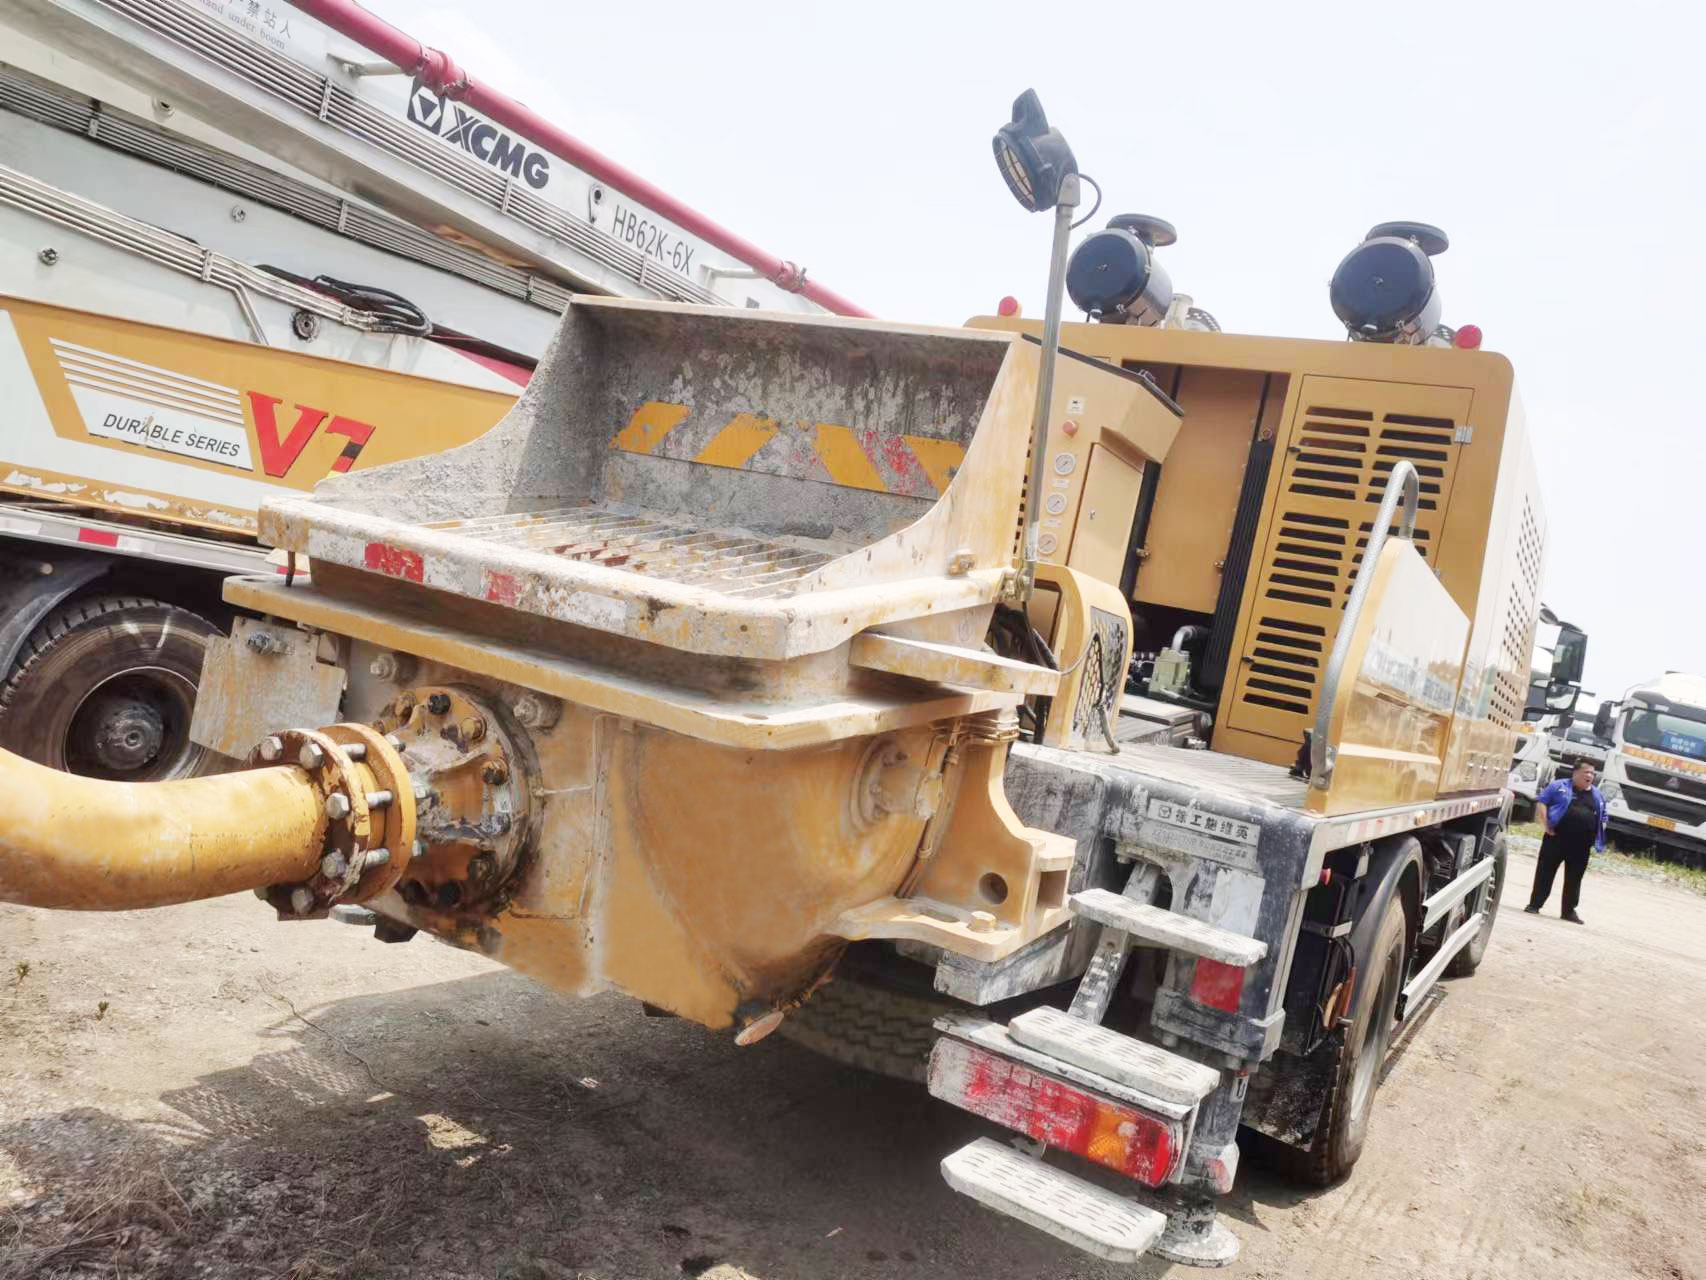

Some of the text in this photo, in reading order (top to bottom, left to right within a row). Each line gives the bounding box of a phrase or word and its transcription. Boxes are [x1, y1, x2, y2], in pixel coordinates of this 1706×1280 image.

[228, 13, 257, 34] under
[260, 28, 285, 50] boom
[441, 105, 549, 189] XCMG
[613, 204, 694, 276] HB62K-6X
[103, 413, 240, 457] DURABLE SERIES
[246, 390, 376, 478] V7
